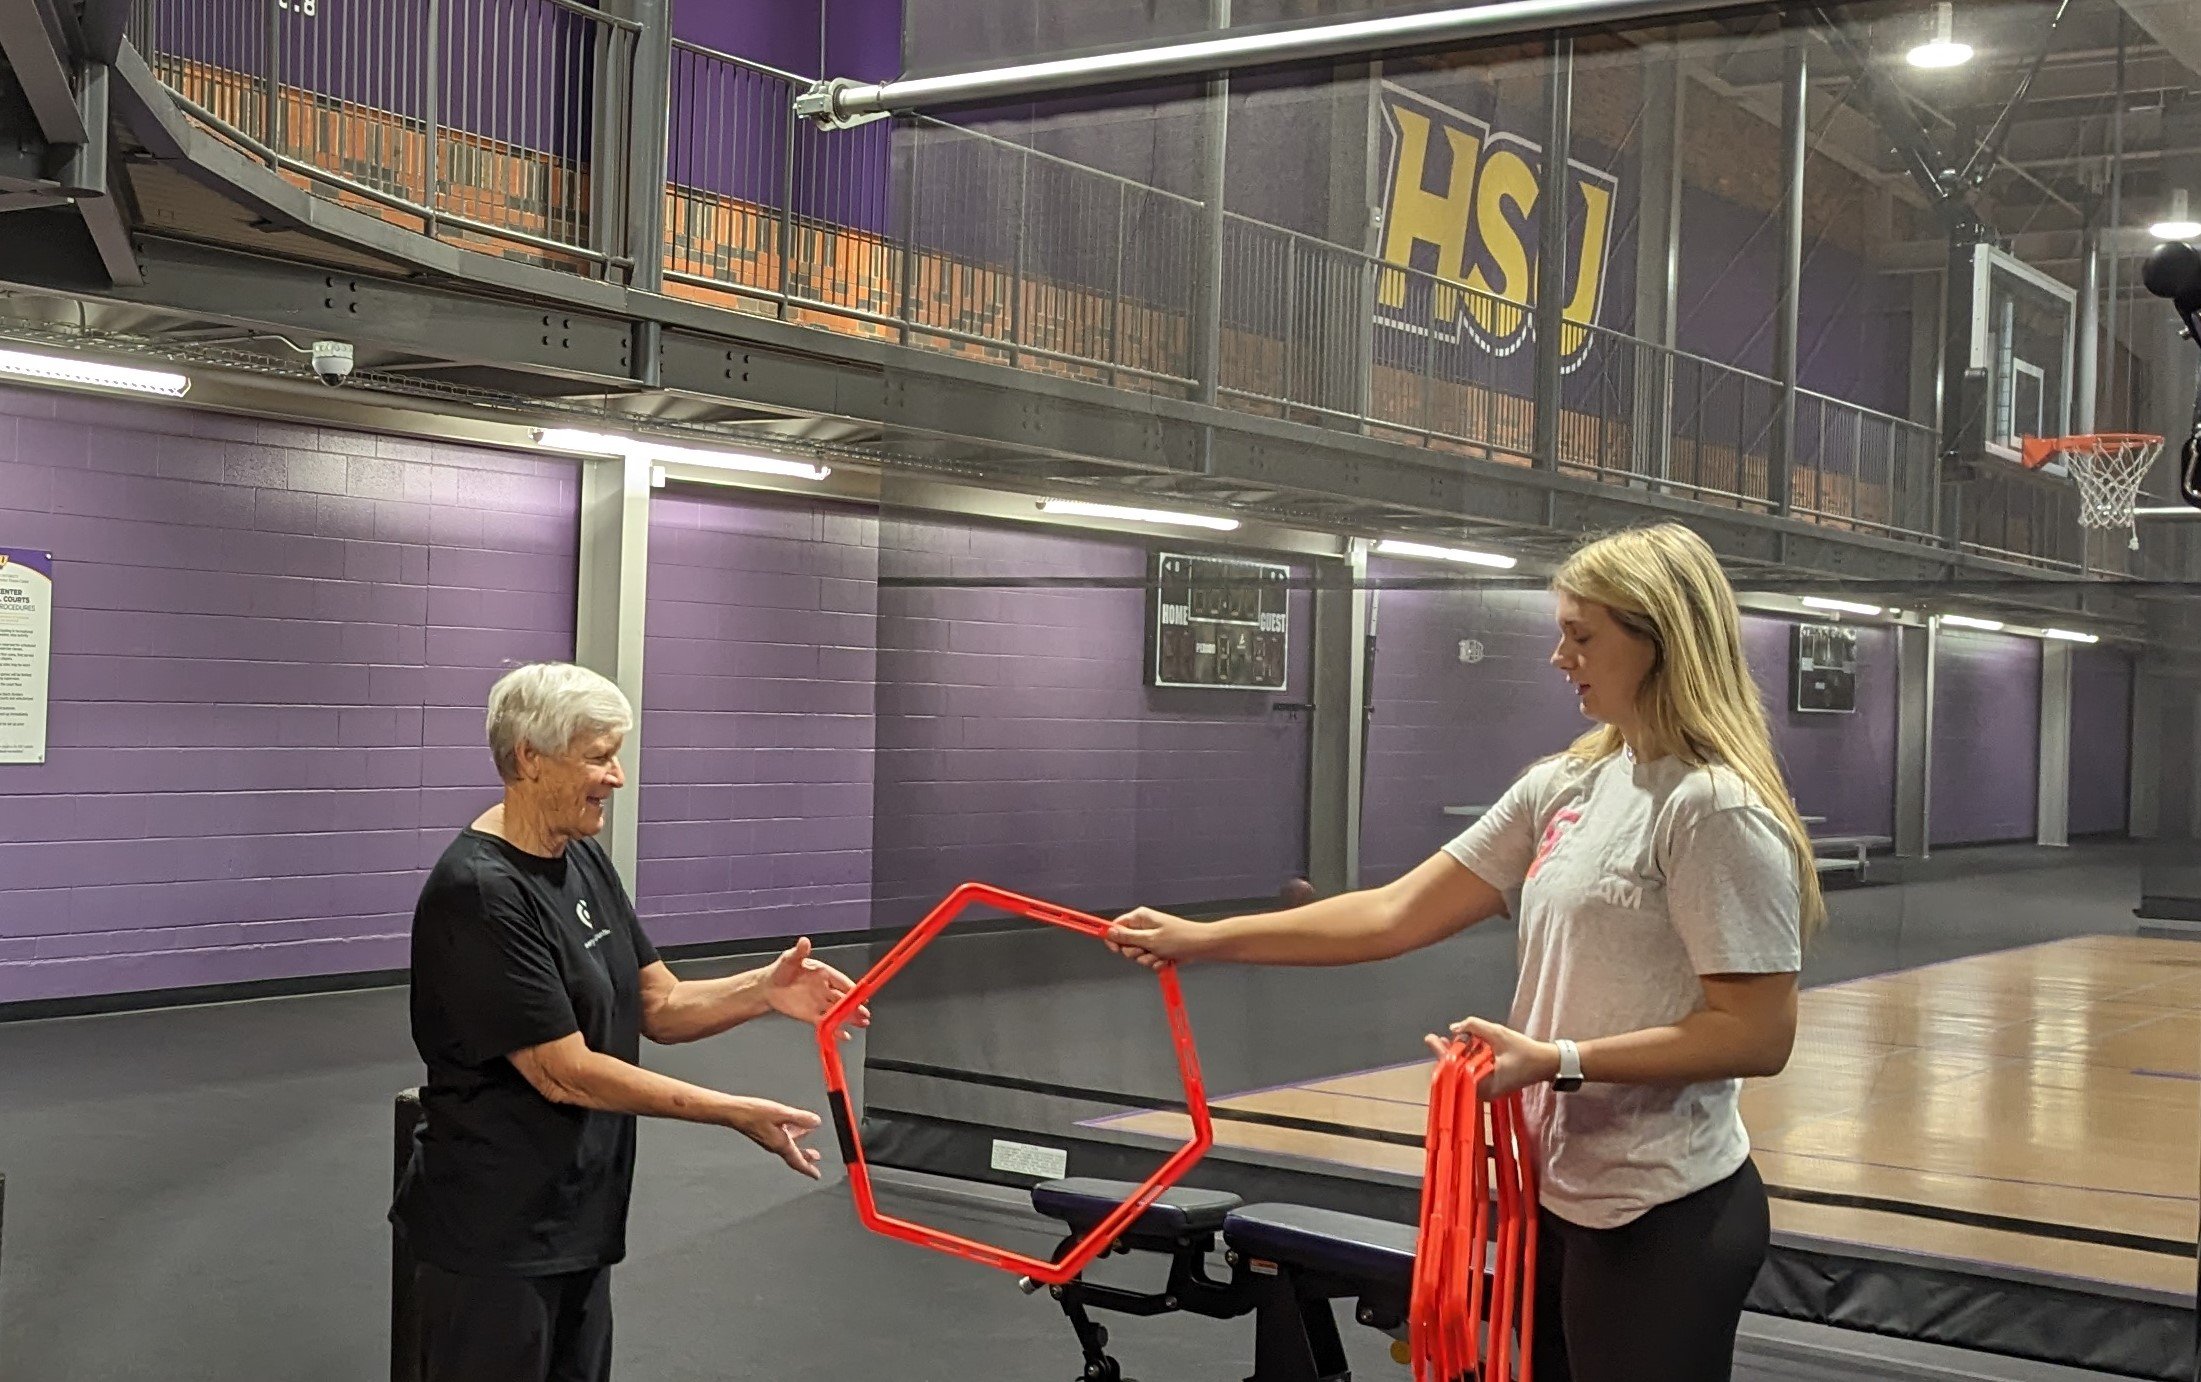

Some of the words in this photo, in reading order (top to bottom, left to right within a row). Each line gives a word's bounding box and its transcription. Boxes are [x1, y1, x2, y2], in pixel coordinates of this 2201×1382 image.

[0, 588, 23, 596] ENTER
[3, 595, 30, 604] COURTS
[0, 604, 36, 612] ROCEDURES
[1162, 603, 1189, 625] HOME
[1260, 613, 1286, 633] GUEST
